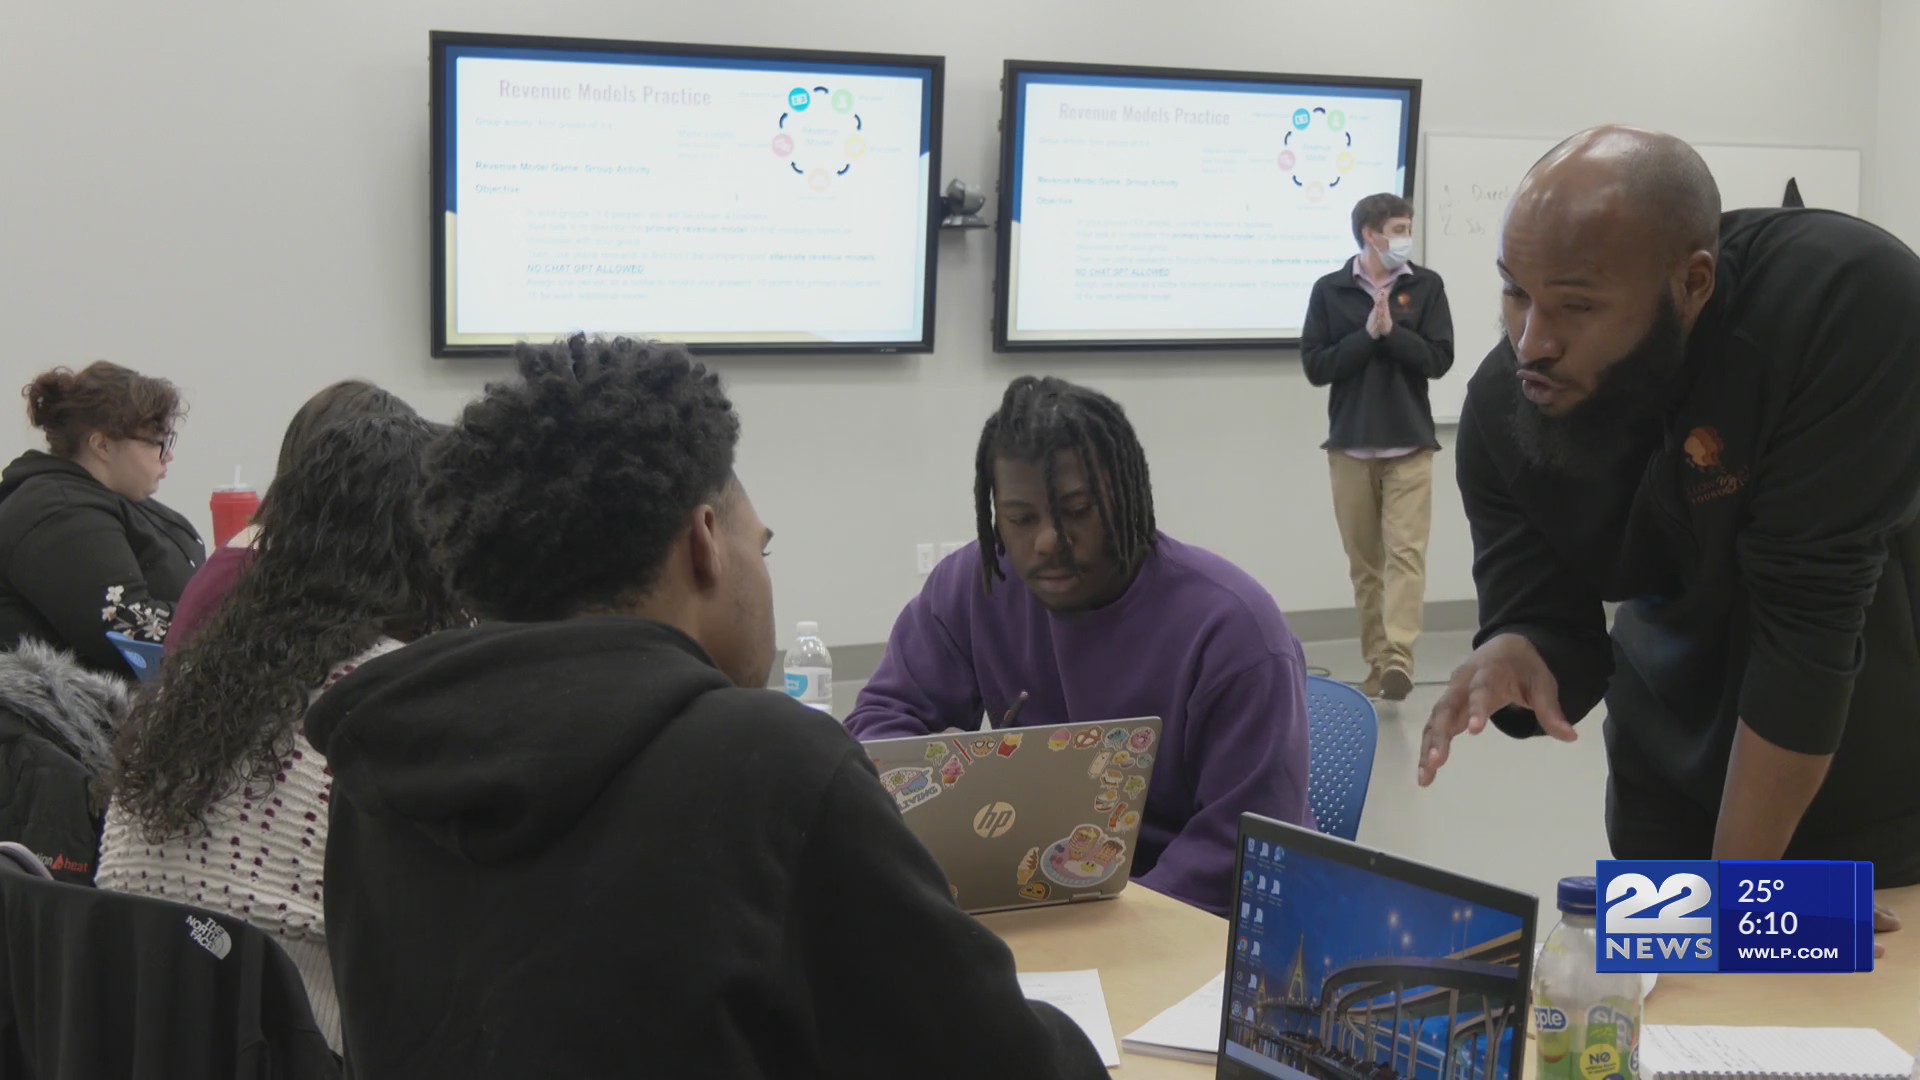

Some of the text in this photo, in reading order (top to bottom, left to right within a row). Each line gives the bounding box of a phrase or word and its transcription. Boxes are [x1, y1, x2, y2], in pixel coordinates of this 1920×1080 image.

[499, 79, 713, 106] Revenue Models Practice
[1059, 103, 1231, 126] Revenue Models Practice
[475, 159, 517, 172] Revenue
[519, 162, 548, 172] Model
[584, 164, 613, 176] Group
[645, 225, 680, 235] primary
[527, 263, 645, 274] NO CHAT GPT ALLOWED
[1131, 267, 1169, 277] ALLOWED
[975, 801, 1015, 839] hp
[64, 857, 88, 873] heat
[185, 914, 218, 944] NORTH
[206, 917, 225, 936] THE
[190, 928, 215, 952] FACE
